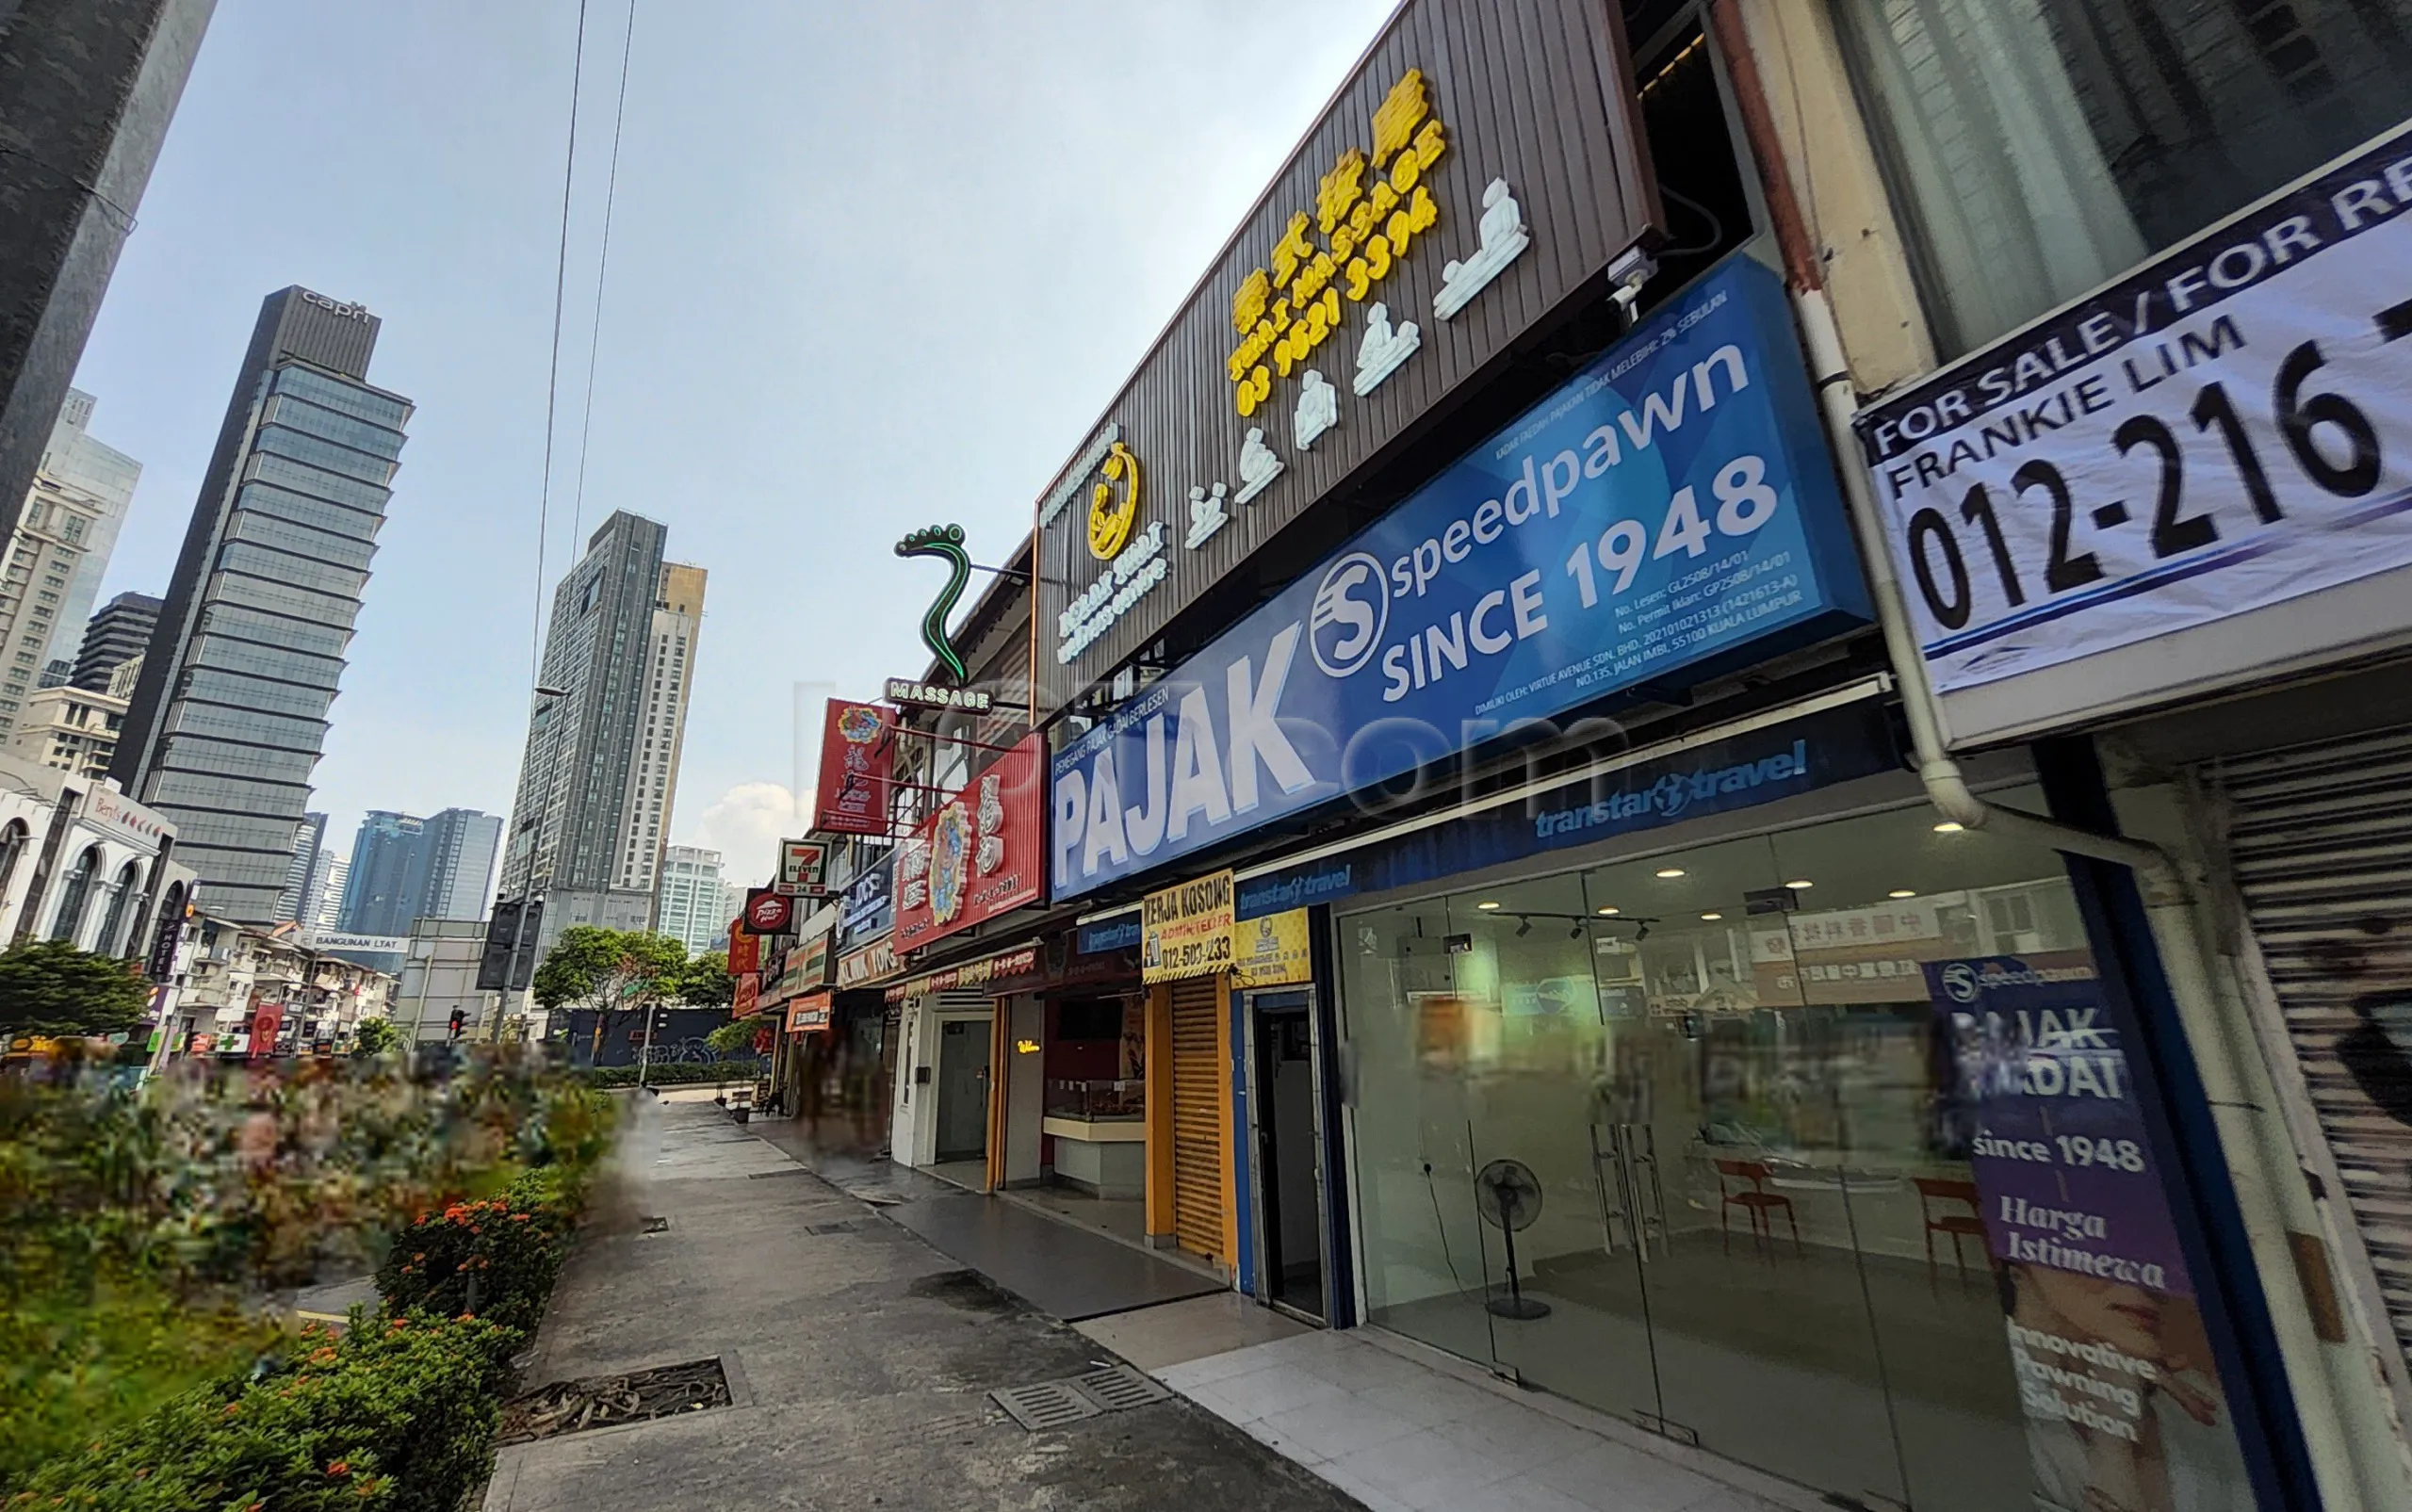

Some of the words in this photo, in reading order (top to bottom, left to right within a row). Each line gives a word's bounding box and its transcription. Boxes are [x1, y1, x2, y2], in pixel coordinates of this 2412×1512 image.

[1292, 119, 1446, 309] MASSAGE
[302, 291, 369, 324] capri
[1874, 388, 1973, 458] FOR
[1977, 311, 2123, 398] SALE
[2165, 216, 2322, 314] FOR
[1585, 374, 1611, 396] TIDAK
[1887, 374, 2115, 500] FRANKIE
[2121, 315, 2247, 395] LIM
[1391, 341, 1750, 598] speedpawn
[1382, 568, 1548, 704] SINCE
[1565, 454, 1779, 610] 1948
[1615, 604, 1633, 619] No.
[1634, 591, 1667, 610] Lesen:
[1613, 653, 1641, 676] JALAN
[1672, 628, 1705, 651] 55100
[1706, 613, 1745, 637] KUALA
[1745, 591, 1803, 621] LUMPUR
[1618, 621, 1637, 635] No.
[1638, 605, 1671, 626] Permit
[1528, 673, 1557, 693] VIRTUE
[1557, 660, 1591, 682] AVENUE
[1592, 649, 1616, 667] SDN.
[1617, 640, 1642, 657] BHD.
[890, 681, 989, 709] MASSAGE
[1130, 685, 1168, 725] BERLESEN
[1054, 620, 1316, 889] PAJAK
[1535, 788, 1655, 839] transtar
[1690, 739, 1806, 800] travel
[1145, 890, 1179, 927] KERJA
[1181, 875, 1230, 919] KOSONG
[1304, 864, 1352, 896] travel
[155, 934, 173, 973] HOTEL
[316, 936, 370, 948] BANGUNAN
[1972, 1130, 2051, 1163] since
[2057, 1133, 2145, 1174] 1948
[1998, 1195, 2107, 1241] Harga
[2008, 1230, 2166, 1291] Istimewa
[2006, 1314, 2158, 1381] Innovative
[2012, 1347, 2143, 1420] Pawning
